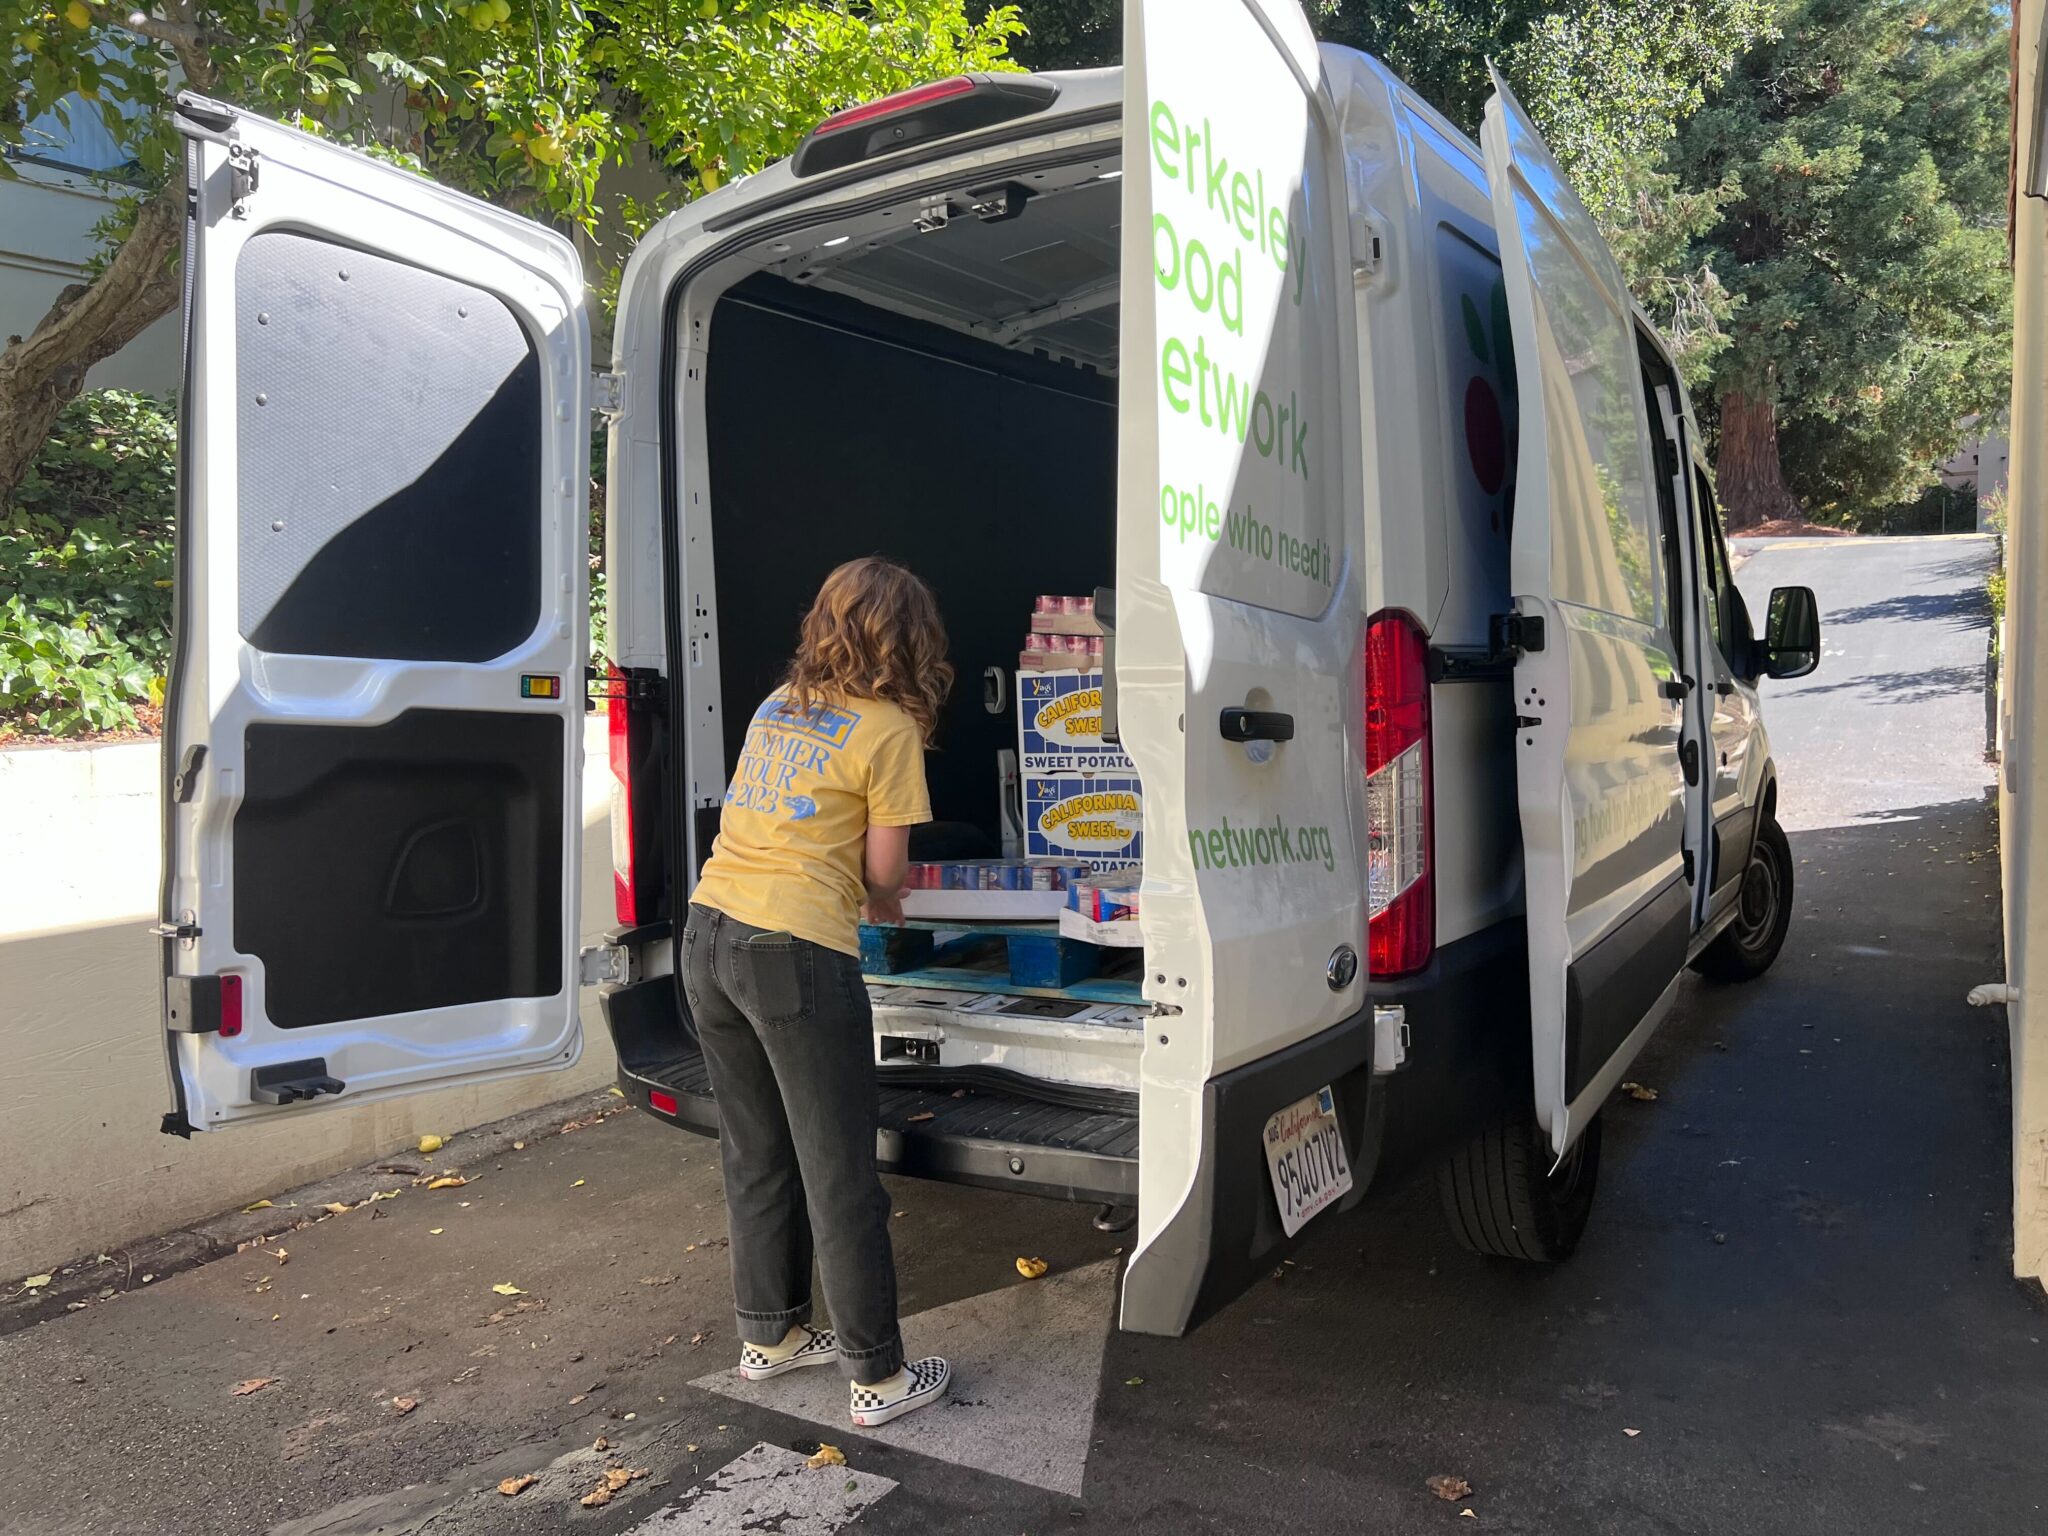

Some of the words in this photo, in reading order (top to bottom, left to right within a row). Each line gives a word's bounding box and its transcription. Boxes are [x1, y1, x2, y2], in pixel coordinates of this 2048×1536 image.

[1150, 100, 1306, 306] erkeley
[1152, 212, 1243, 337] ood
[1162, 337, 1308, 481] etwork
[1161, 484, 1221, 544] ople
[1227, 504, 1273, 561] who
[1279, 531, 1320, 582] need
[1324, 542, 1332, 587] it
[1037, 690, 1102, 727] CALIFOR
[1065, 717, 1102, 734] SWE
[743, 731, 831, 776] UMMER
[743, 755, 798, 791] TOUR
[1025, 756, 1073, 768] SWEET
[1077, 755, 1134, 768] POTATO
[736, 782, 779, 813] 2023
[1041, 794, 1136, 830] CALIFORNIA
[1188, 814, 1335, 872] network.org
